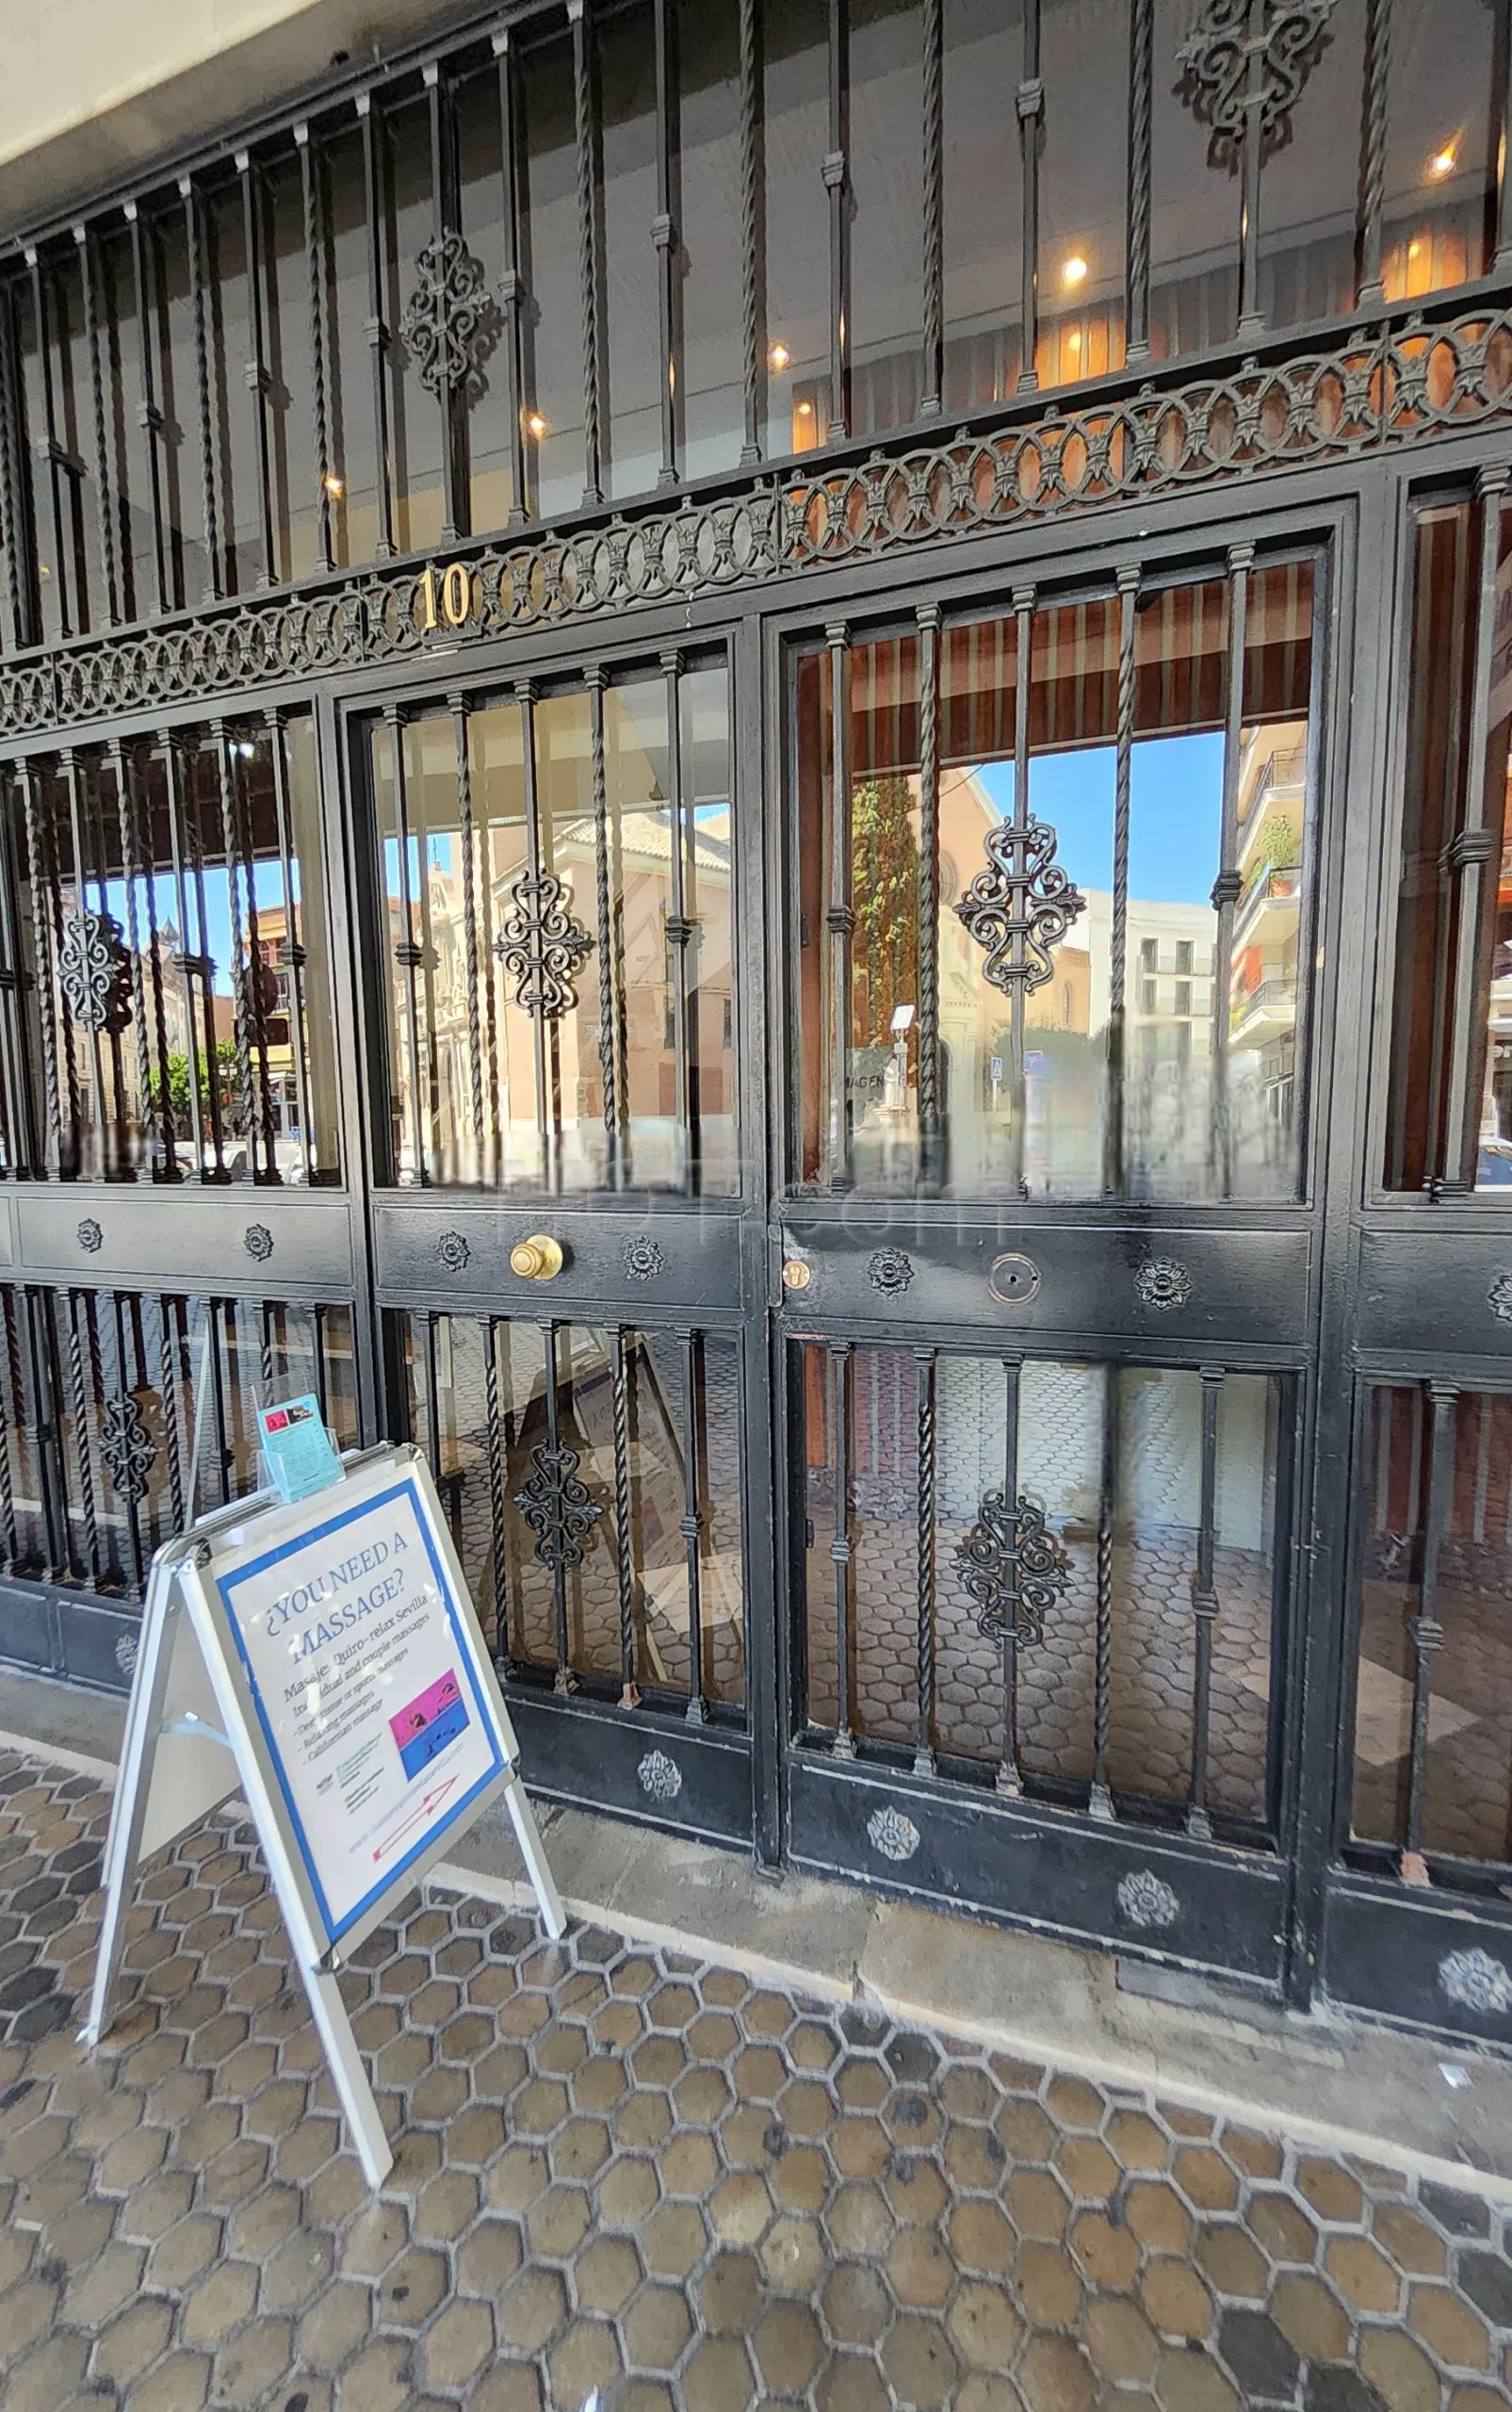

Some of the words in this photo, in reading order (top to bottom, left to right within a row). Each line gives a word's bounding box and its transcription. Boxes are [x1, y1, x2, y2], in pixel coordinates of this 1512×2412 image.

[418, 562, 469, 628] 10
[266, 1575, 326, 1638] ¿YOU
[328, 1540, 389, 1593] NEED
[394, 1531, 409, 1555] A
[288, 1567, 405, 1666] MASSAGE?
[333, 1616, 397, 1667] Quiro-relax
[395, 1595, 429, 1623] Sevilla
[344, 1659, 363, 1681] and
[362, 1640, 392, 1668] couple
[391, 1612, 431, 1645] massages
